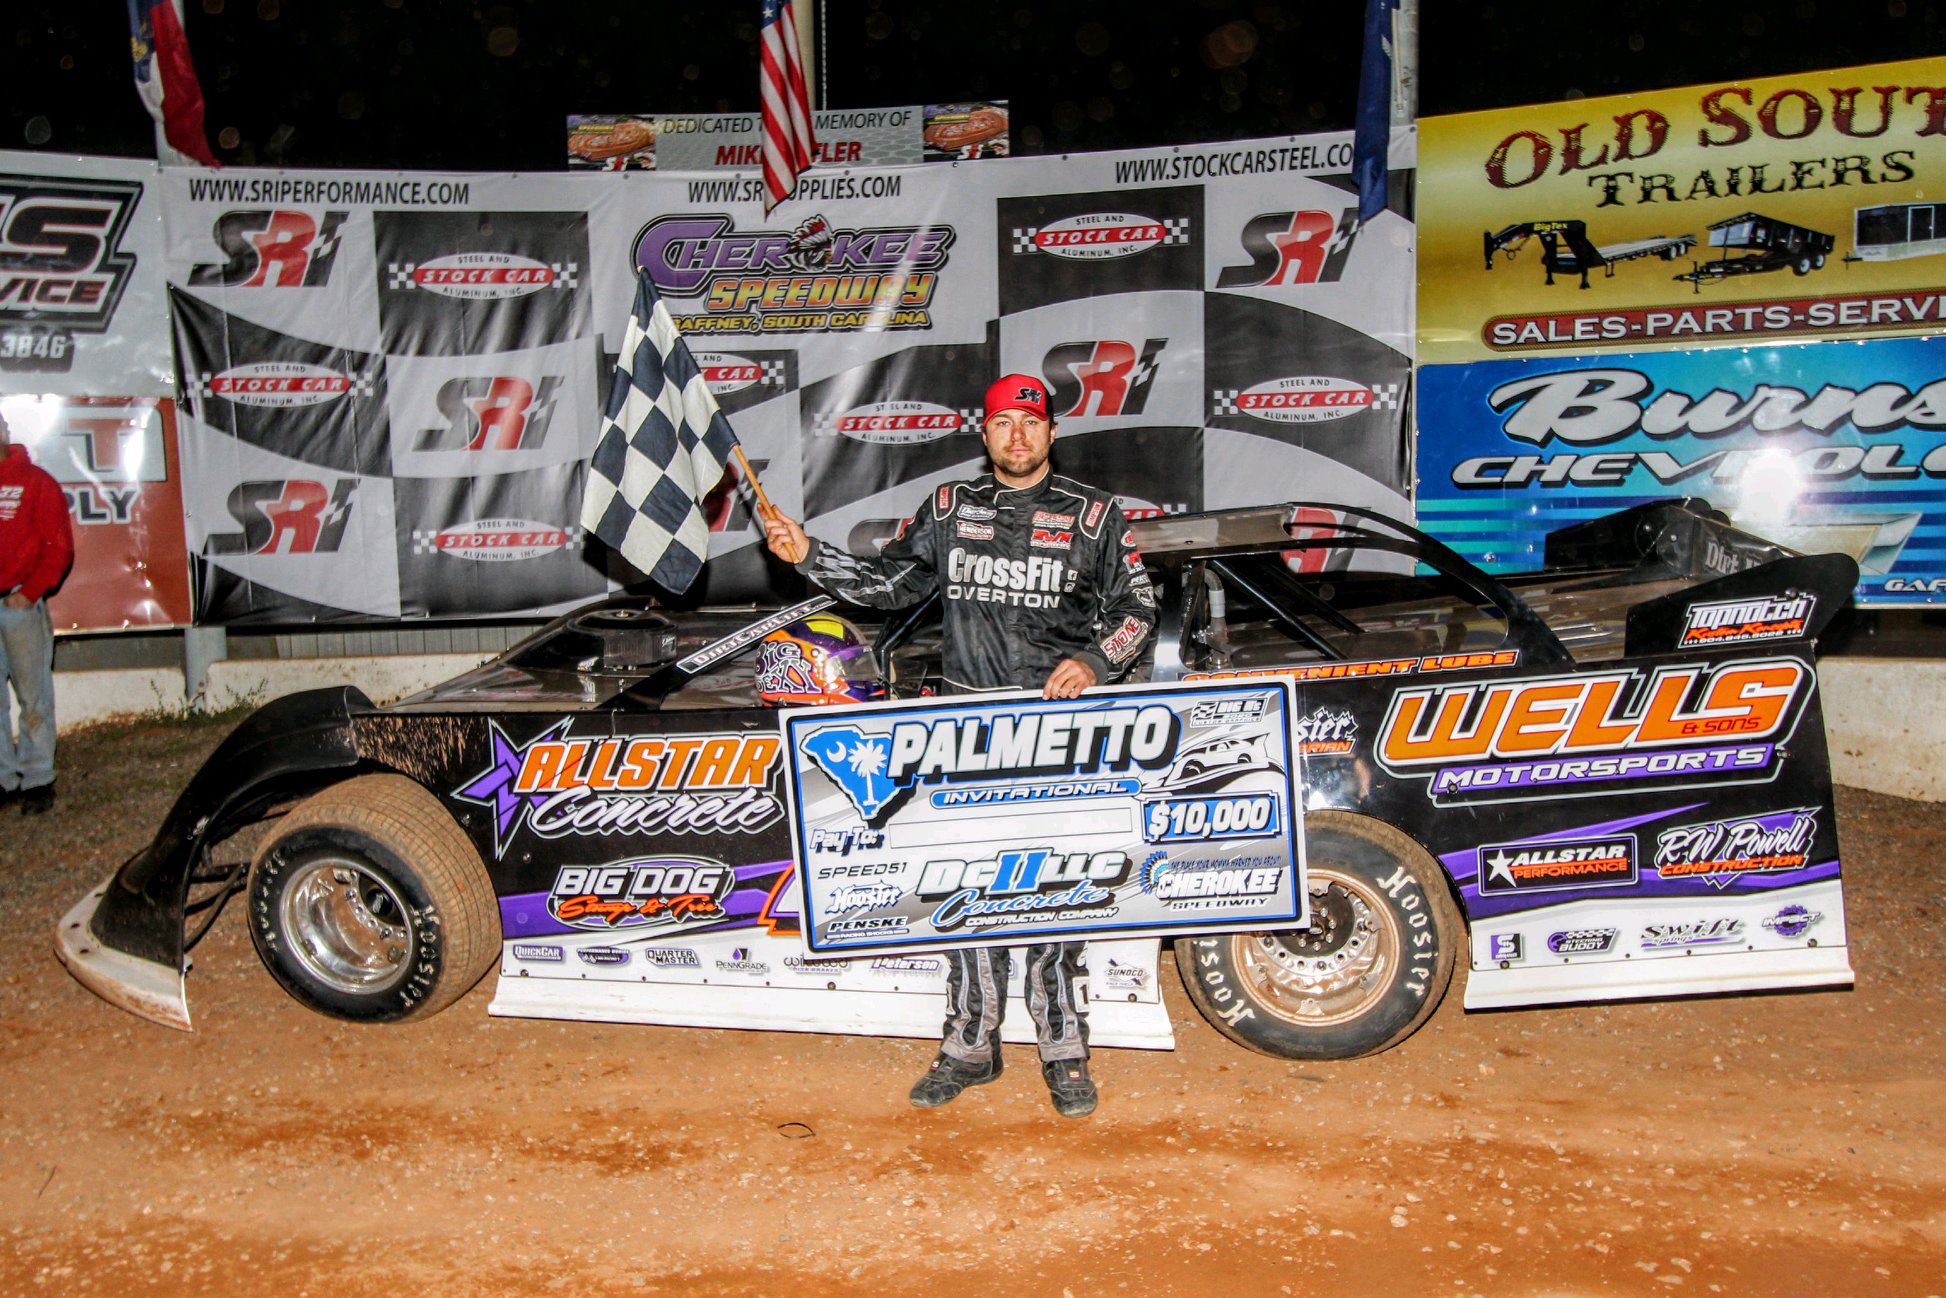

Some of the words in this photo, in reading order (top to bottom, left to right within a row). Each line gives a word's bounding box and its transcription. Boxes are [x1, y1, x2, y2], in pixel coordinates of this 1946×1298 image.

[663, 117, 753, 134] DEDICATED
[814, 112, 888, 130] MEMORY
[889, 110, 912, 126] OF
[715, 144, 763, 166] MIK
[1484, 108, 1671, 188] OLD
[1115, 142, 1354, 184] WWW.STOCKCARSTEEL.CO
[688, 174, 901, 204] WWW.SRPPLIES.COM
[1588, 149, 1917, 208] TRAILERS
[188, 177, 470, 205] WWW.SRIPERFORMANCE.COM
[1075, 216, 1101, 226] STEEL
[1105, 214, 1125, 223] AND
[1533, 221, 1568, 231] BigTex
[1043, 229, 1108, 246] STOCK
[1118, 226, 1160, 241] CAR
[423, 269, 496, 283] STOCK
[504, 269, 548, 282] CAR
[706, 272, 936, 312] SPEEDWAY
[763, 312, 827, 328] SOUTH
[830, 311, 928, 327] CARLINA
[220, 378, 291, 392] STOCK
[301, 377, 344, 391] CAR
[716, 367, 756, 380] CAR
[1279, 379, 1307, 389] STEEL
[1309, 378, 1331, 387] AND
[1245, 392, 1314, 408] STOCK
[1324, 391, 1366, 406] CAR
[844, 416, 908, 431] STOCK
[917, 415, 956, 429] CAR
[1263, 410, 1318, 422] ALUMINUM,
[1322, 410, 1344, 419] INC.
[444, 533, 511, 548] STOCK
[520, 532, 560, 546] CAR
[948, 547, 1064, 593] CrossFit
[946, 584, 1061, 609] OVERTON
[1183, 658, 1420, 682] ENIENT
[1420, 650, 1518, 672] LUBE
[1382, 663, 1802, 764] WELLS
[1298, 711, 1351, 742] sier
[886, 704, 1173, 780] PALMETTO
[513, 734, 782, 793] ALLSTAR
[1440, 746, 1769, 789] MOTORSPORTS
[943, 783, 1129, 804] INVITATIONAL
[530, 785, 777, 833] Concrete
[1148, 797, 1272, 842] $10,000
[810, 829, 848, 853] Pay
[1724, 817, 1811, 861] Powell
[1513, 845, 1627, 867] ALLSTAR
[1660, 854, 1805, 876] CONSTRUCTION
[818, 861, 908, 879] SPEED51
[1513, 860, 1629, 879] PERFORMANCE
[554, 866, 627, 896] BIG
[630, 866, 725, 896] DOG
[1157, 868, 1281, 899] CHEROKEE
[1172, 897, 1269, 910] SPEEDWAY
[829, 917, 907, 932] PENSKE
[965, 911, 1055, 926] CONSTRUCTION
[1058, 907, 1119, 921] COMPANY
[1762, 911, 1822, 927] IMPACT
[1640, 917, 1741, 939] Swift
[647, 949, 693, 960] QUARTER
[1558, 941, 1605, 952] BUDDY
[655, 955, 696, 965] MASTER
[872, 957, 940, 971] Peterson
[1107, 968, 1144, 977] SUNOCO
[1192, 939, 1257, 1028] Hoosi
